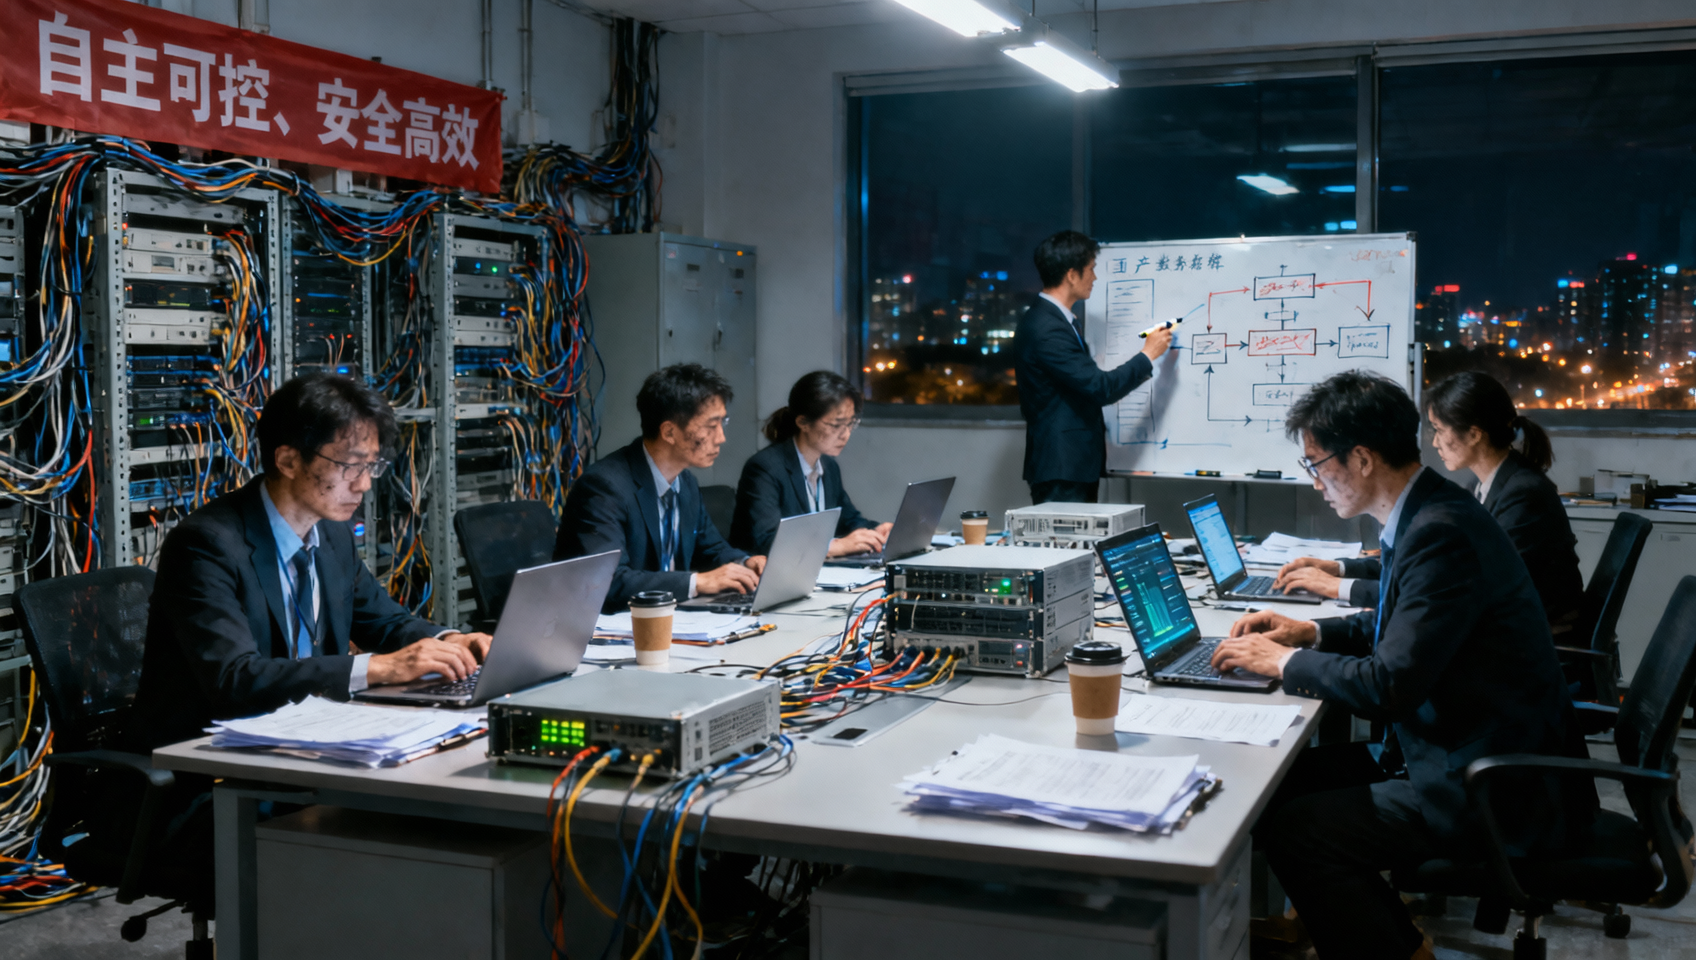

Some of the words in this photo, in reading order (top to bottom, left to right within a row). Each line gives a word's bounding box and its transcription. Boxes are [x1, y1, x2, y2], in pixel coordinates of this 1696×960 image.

[39, 11, 479, 170] 自主可控、安全高效
